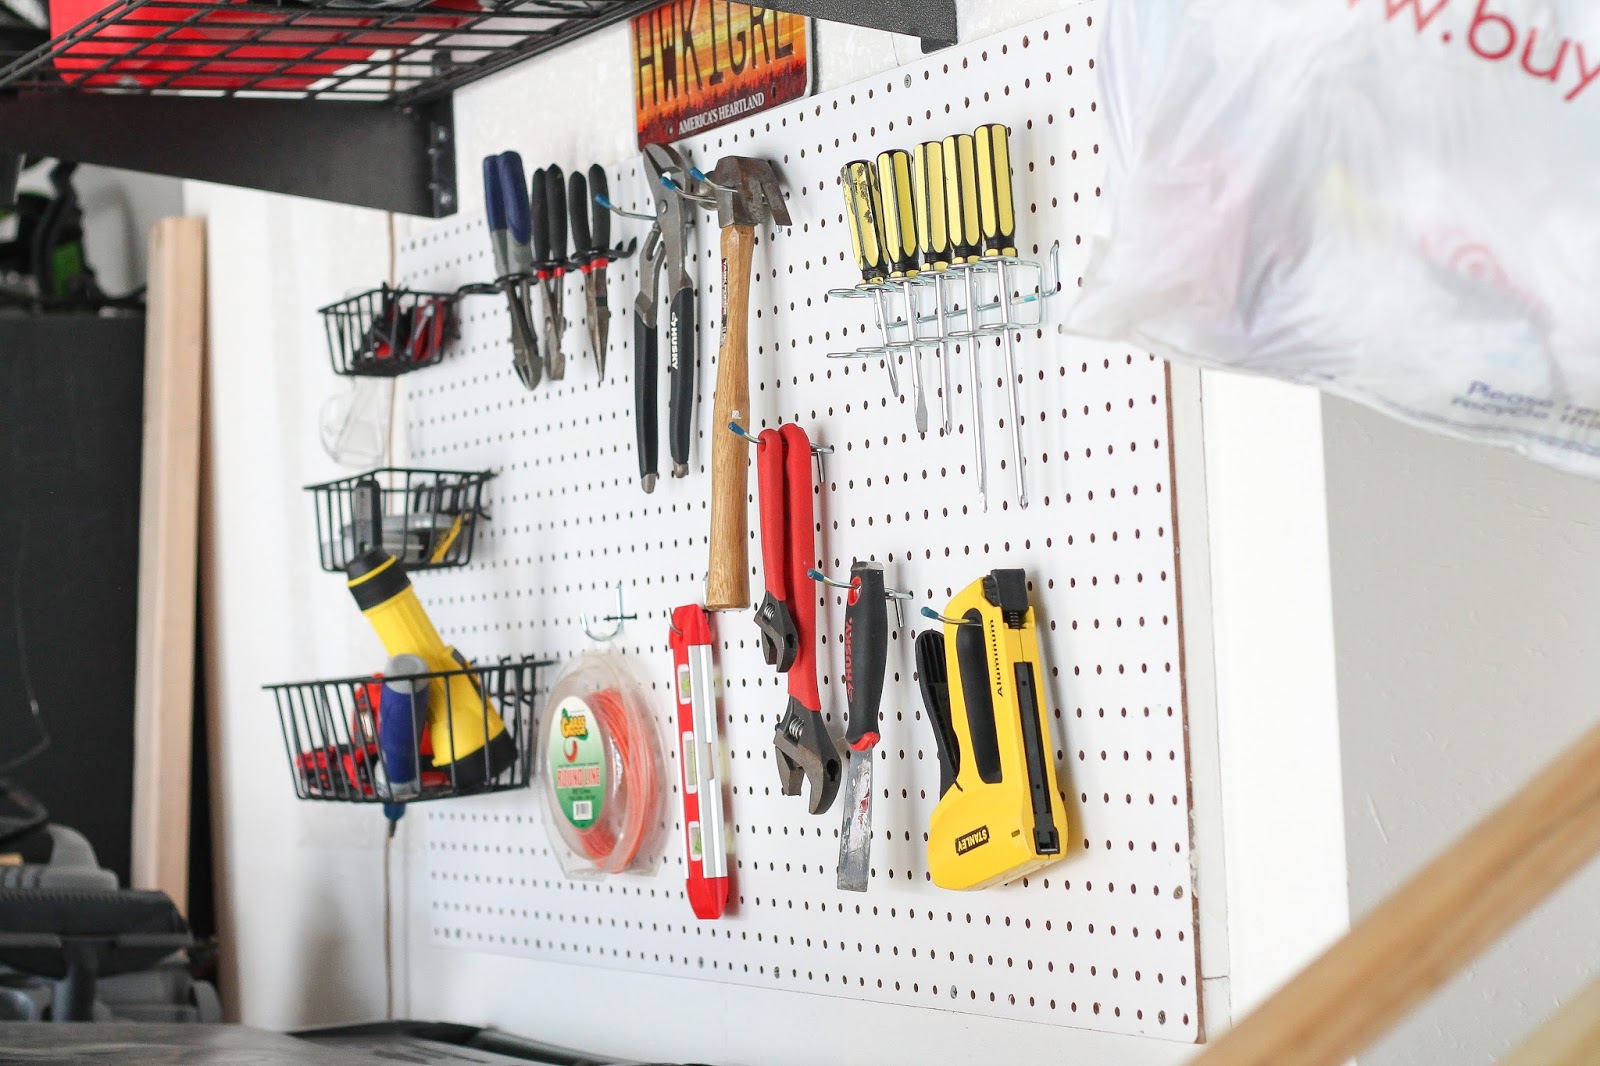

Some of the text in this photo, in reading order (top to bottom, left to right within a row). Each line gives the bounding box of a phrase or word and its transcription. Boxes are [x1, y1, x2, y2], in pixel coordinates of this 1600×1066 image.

[678, 92, 766, 135] AMERICA'S HEARTLAND
[671, 326, 679, 370] HUSKY
[989, 619, 1004, 697] Aluminum
[556, 766, 601, 789] ROUND LINE
[957, 828, 988, 853] STANLEY
